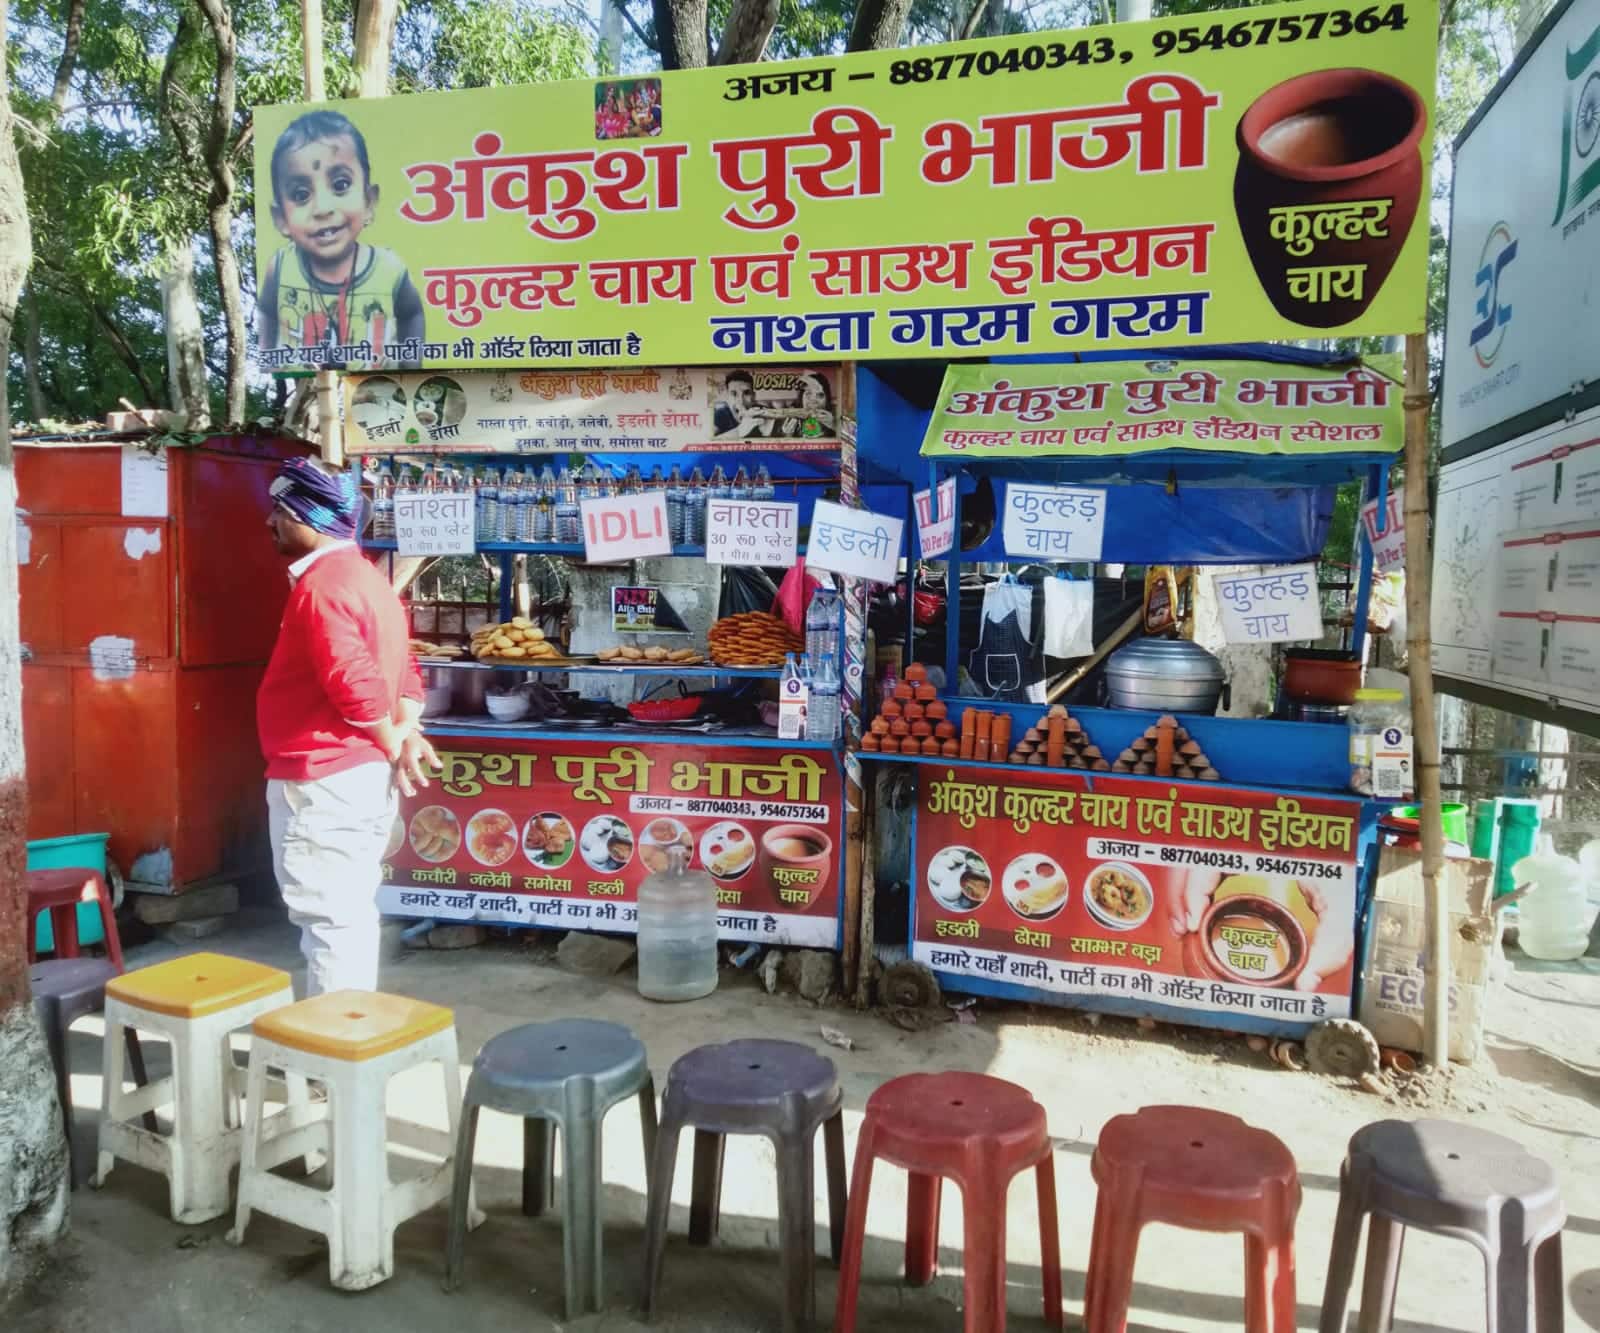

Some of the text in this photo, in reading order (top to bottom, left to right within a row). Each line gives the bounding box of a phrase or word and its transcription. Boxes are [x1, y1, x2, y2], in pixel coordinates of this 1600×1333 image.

[722, 68, 835, 100] अजय
[888, 38, 1134, 86] 8877040343,
[1151, 3, 1409, 58] 9546757364
[399, 73, 1219, 241] अंकुश पुरी भाजी
[1269, 198, 1393, 304] कुल्हर चाय
[424, 216, 1217, 327] कुल्हर चाय एवं साउथ इंडियन
[710, 291, 1211, 356] नाश्ता गरम गरम
[258, 344, 297, 367] हमारे
[384, 337, 422, 361] पार्टी
[422, 341, 448, 361] का
[453, 336, 474, 359] भी
[480, 335, 526, 360] ऑर्डर
[530, 334, 572, 358] लिया
[577, 336, 621, 356] जाता
[625, 331, 642, 355] है
[945, 367, 1394, 421] अंकुश पुरी भाजी
[943, 429, 1015, 449] कुल्हर
[1020, 428, 1065, 446] चाय
[1074, 421, 1113, 446] एवं
[1117, 421, 1184, 443] साउथ
[1290, 420, 1382, 442] स्पेशल
[397, 498, 469, 519] नाश्ता
[712, 504, 793, 529] नाश्ता
[1012, 488, 1098, 524] कुल्हड़
[587, 506, 663, 545] IDLI
[711, 534, 727, 545] 30
[816, 521, 892, 560] इडली
[1025, 529, 1073, 553] चाय
[1218, 567, 1310, 611] कुल्हड़
[1242, 614, 1290, 638] चाय
[423, 747, 827, 805] कुश पूरी भाजी
[636, 797, 672, 811] अजय
[760, 805, 826, 820] 9546757364
[927, 769, 1356, 853] अंकुश कुल्हर चाय एवं साउथ इंडियन
[1096, 841, 1141, 859] अजय
[1255, 857, 1343, 881] 9546757364
[524, 875, 572, 893] समोसा
[587, 878, 625, 897] इडली
[772, 867, 819, 904] कुल्हर चाय
[400, 891, 442, 908] हमारे
[444, 893, 477, 909] यहाँ
[529, 898, 563, 916] पार्टी
[567, 903, 592, 919] का
[595, 903, 617, 920] भी
[763, 915, 778, 933] है
[935, 918, 980, 938] इडली
[1221, 923, 1281, 973] कुल्हर चाय
[930, 948, 972, 971] हमारे
[974, 952, 1008, 976] यहाँ
[1060, 964, 1096, 988] पार्टी
[1101, 973, 1127, 992] का
[1130, 972, 1154, 995] भी
[1158, 976, 1206, 1004] ऑर्डर
[1209, 984, 1255, 1011] लिया
[1259, 993, 1305, 1016] जाता
[1308, 995, 1328, 1018] है
[1380, 974, 1457, 1011] EGS
